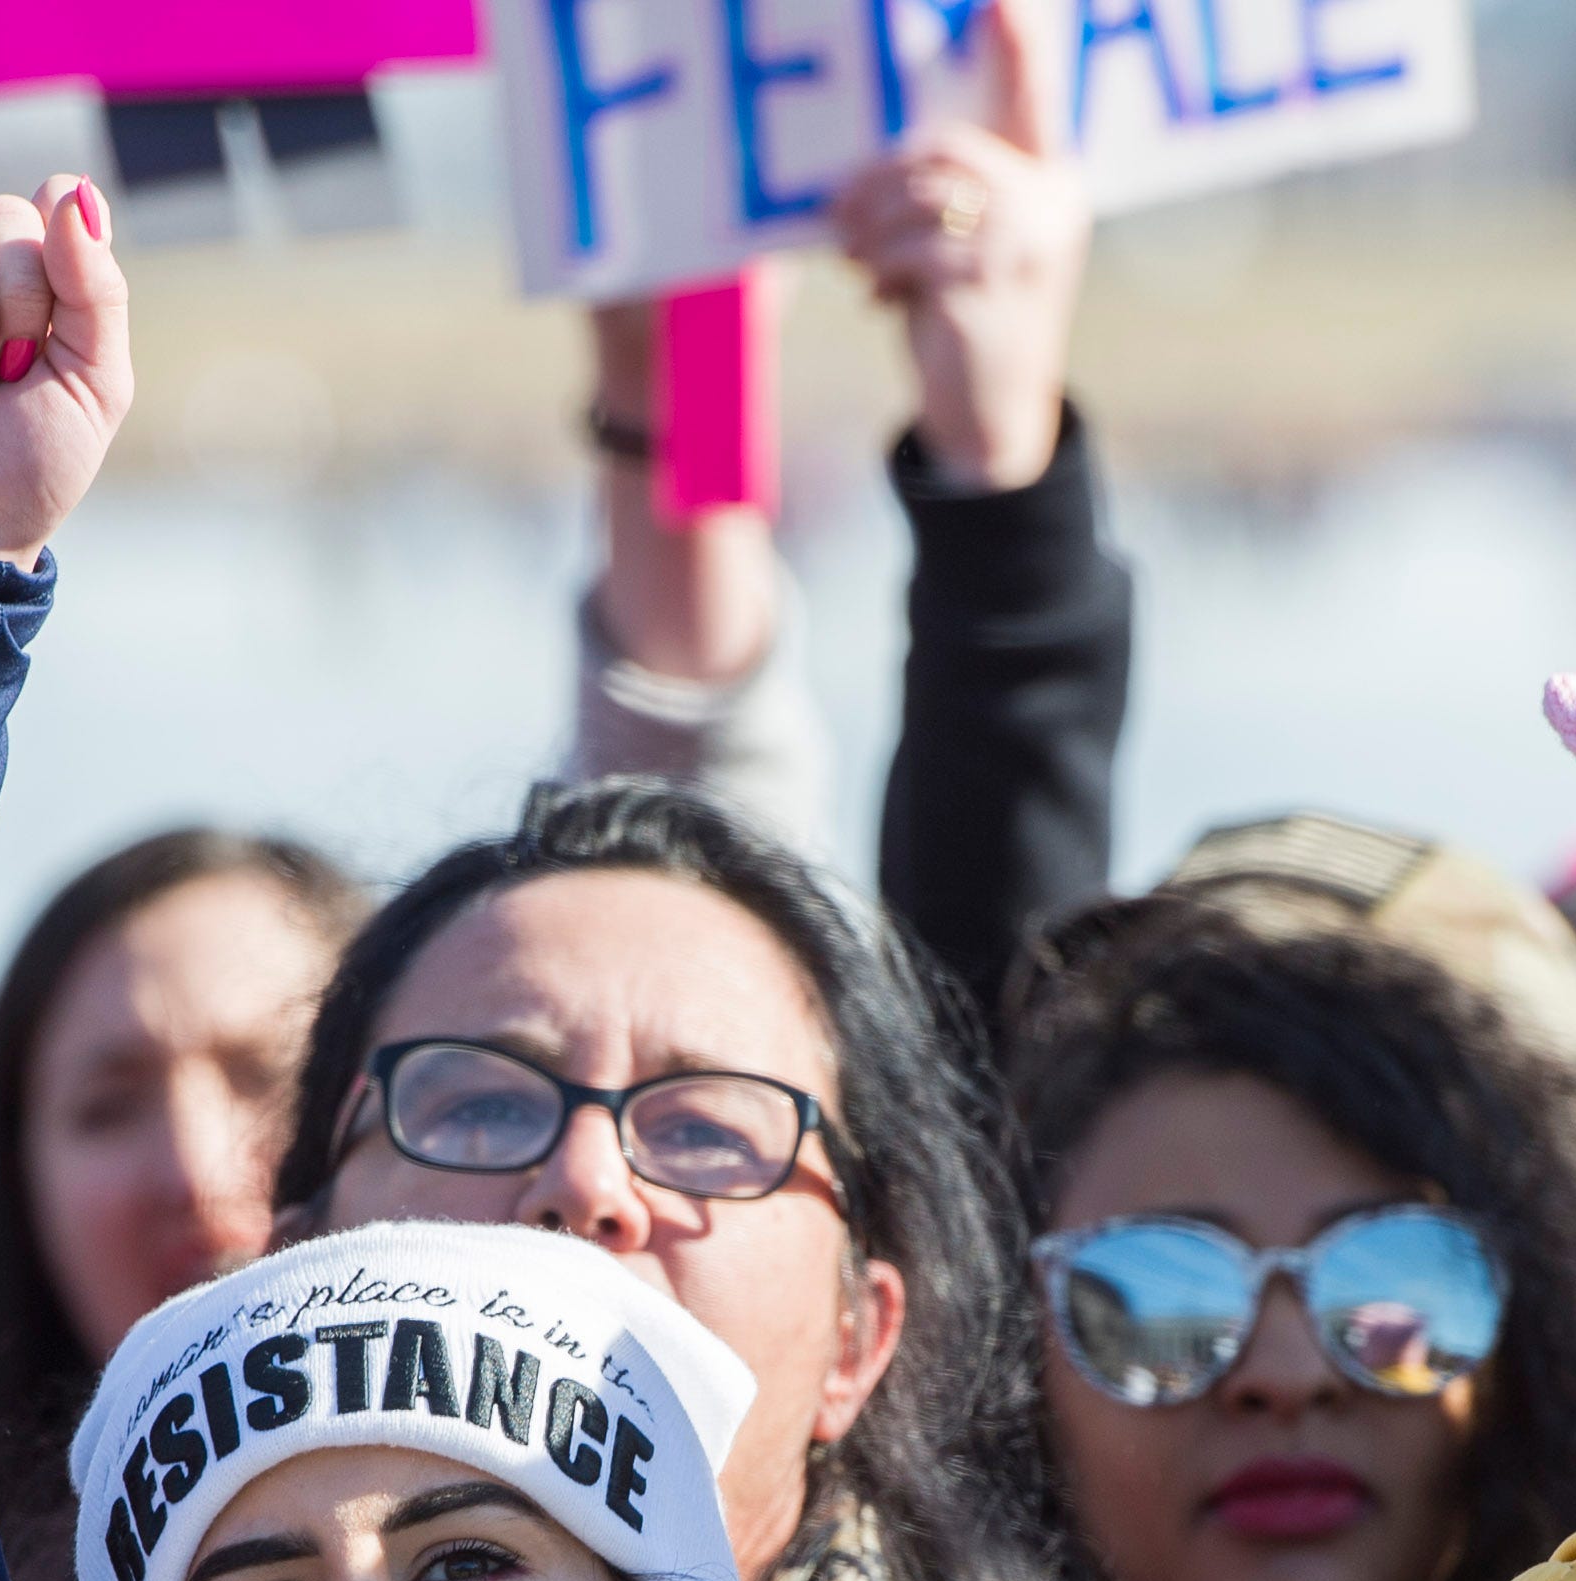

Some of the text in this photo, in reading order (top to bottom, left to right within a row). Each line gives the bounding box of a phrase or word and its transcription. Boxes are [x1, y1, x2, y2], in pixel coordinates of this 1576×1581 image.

[286, 1267, 458, 1330] place
[479, 1289, 535, 1329] is
[542, 1318, 586, 1360] in
